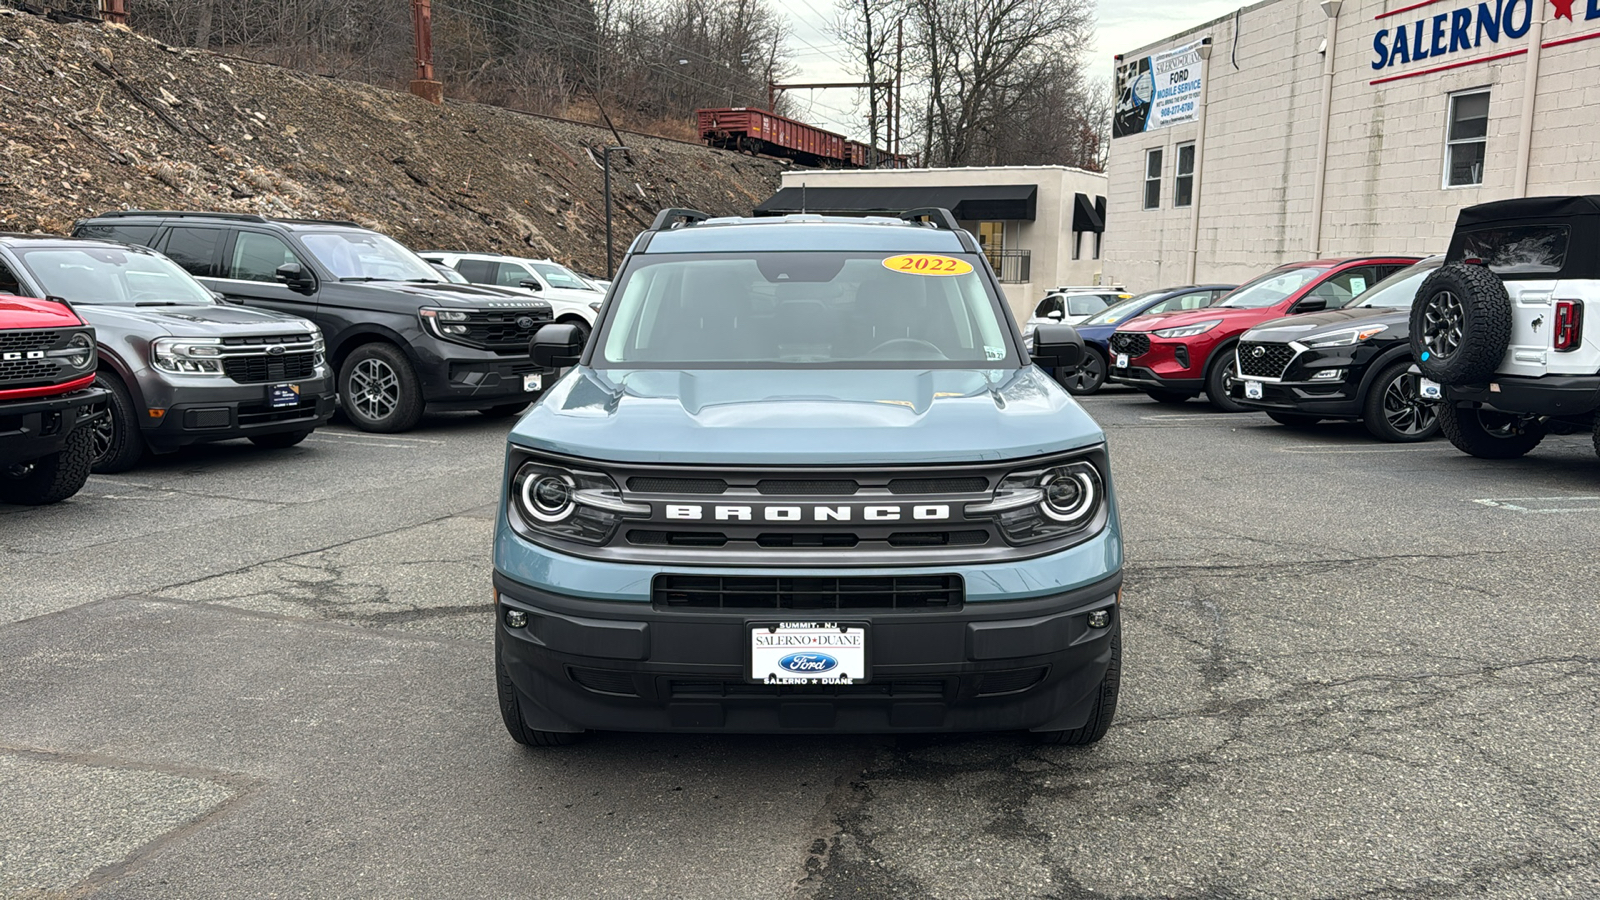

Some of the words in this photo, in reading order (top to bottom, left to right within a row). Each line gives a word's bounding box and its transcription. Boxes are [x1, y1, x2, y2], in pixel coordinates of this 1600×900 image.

[1371, 0, 1533, 70] SALERNO
[1170, 68, 1189, 85] FORD
[1157, 85, 1177, 99] MOBILE
[1177, 79, 1201, 95] SERVICE
[900, 257, 957, 272] 2022
[665, 504, 950, 521] BRONCO
[756, 635, 812, 646] SALERNO
[818, 635, 861, 646] DUANE
[789, 654, 827, 670] Ford
